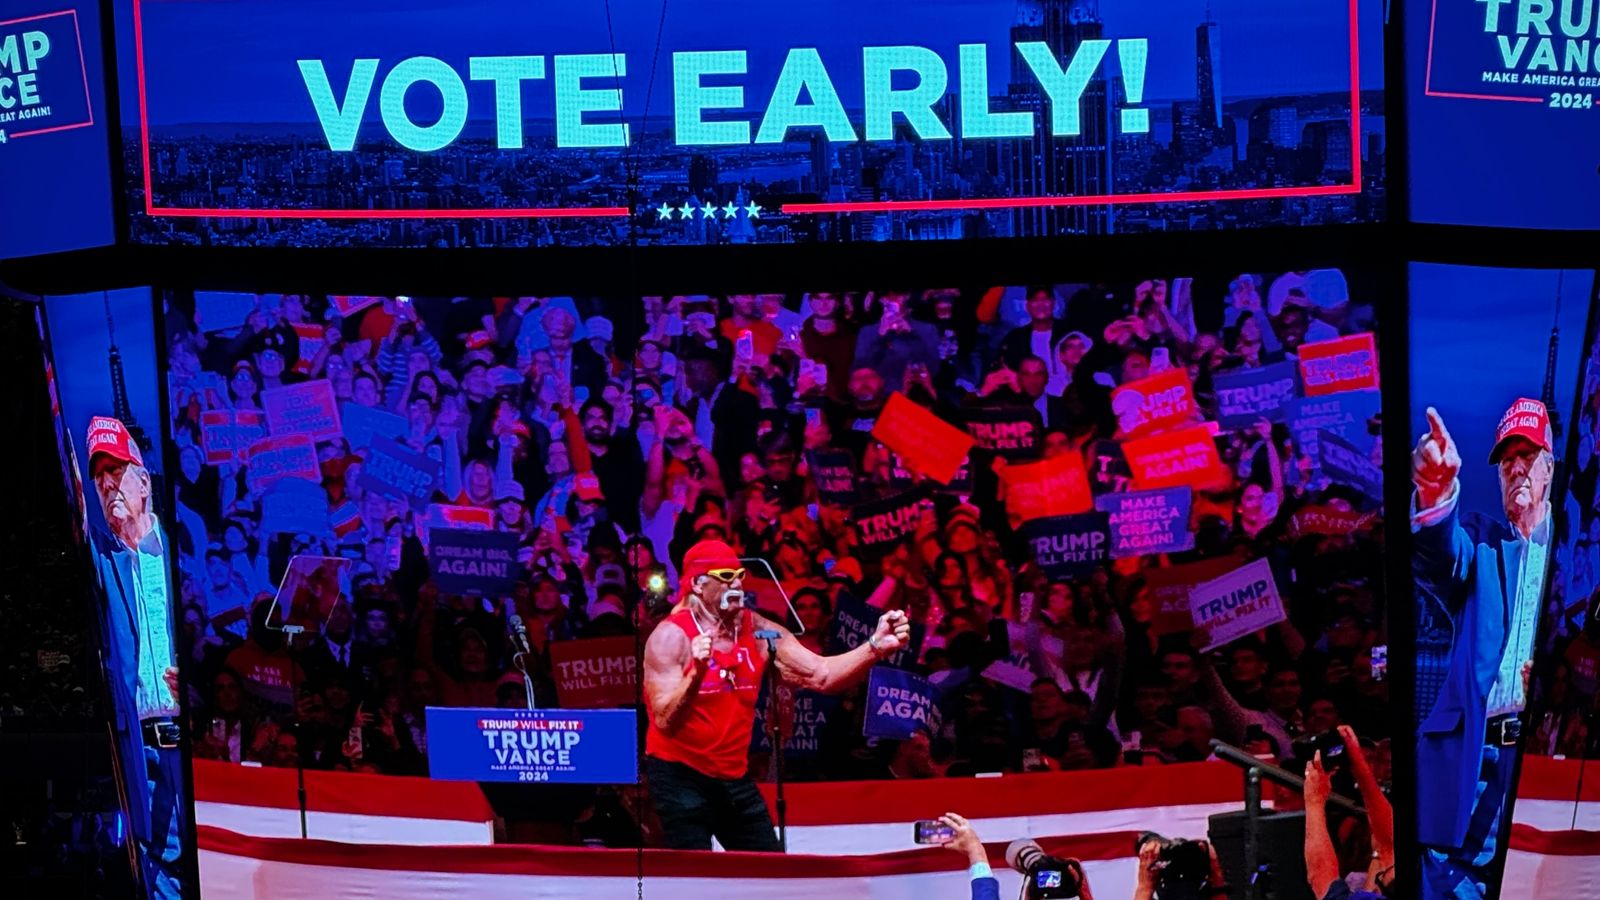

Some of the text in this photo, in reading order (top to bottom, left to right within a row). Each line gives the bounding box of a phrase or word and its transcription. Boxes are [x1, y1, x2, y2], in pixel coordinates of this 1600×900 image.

[1475, 0, 1600, 38] TRU
[1482, 71, 1519, 84] MAKE
[1522, 73, 1575, 87] AMERICA
[297, 38, 1149, 152] VOTE EARLY!
[1549, 92, 1592, 109] 2024
[18, 106, 51, 120] AGAIN!
[1142, 386, 1186, 412] UMP
[1217, 378, 1294, 406] TRUMP
[968, 422, 1034, 439] TRUMP
[1121, 496, 1166, 510] MAKE
[857, 503, 920, 535] TRUM
[1109, 507, 1180, 525] AMERICA
[1119, 520, 1172, 536] GREAT
[1119, 533, 1173, 549] AGAIN!
[1063, 551, 1087, 563] FIX
[1091, 548, 1105, 560] IT
[438, 559, 508, 578] AGAIN!
[1198, 580, 1267, 620] TRUMP
[557, 655, 637, 679] TRUMP
[561, 679, 596, 691] WILL
[600, 676, 623, 687] FIX
[877, 686, 930, 709] DREAM
[482, 720, 579, 731] TRUMP WILL FIX IT
[483, 730, 580, 750] TRUMP
[495, 749, 571, 766] VANCE
[519, 771, 549, 781] 2024
